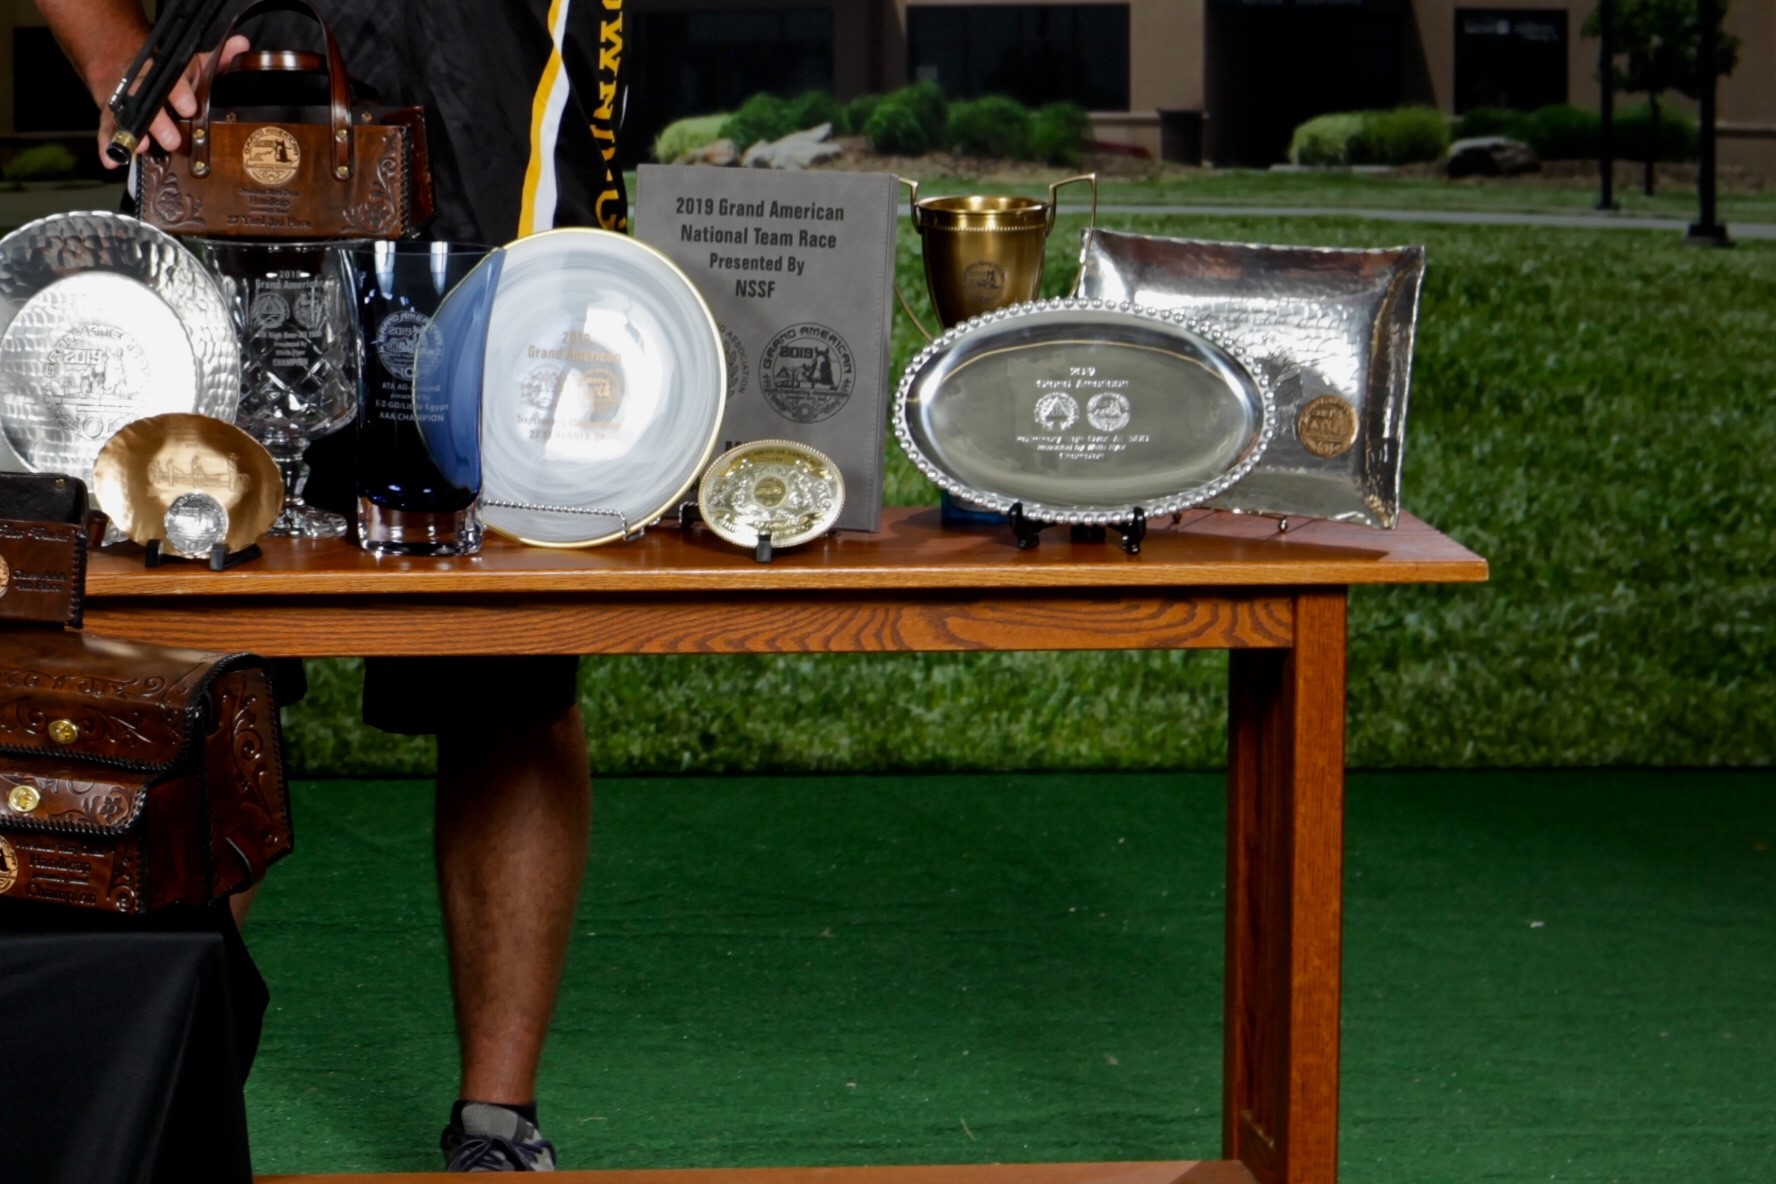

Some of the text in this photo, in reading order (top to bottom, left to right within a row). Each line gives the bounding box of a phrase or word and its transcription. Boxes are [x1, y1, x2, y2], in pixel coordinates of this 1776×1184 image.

[675, 197, 845, 221] 2019 Grand American
[241, 215, 266, 226] Yard
[680, 224, 837, 249] National Team Race
[709, 252, 805, 276] Presented By
[255, 278, 325, 290] Grand American
[735, 279, 776, 298] NSSF
[63, 348, 103, 365] 2019
[527, 344, 621, 363] Grand American
[763, 326, 852, 374] GRAND AMERICAN
[779, 346, 814, 359] 2019
[272, 358, 309, 367] CHAMPION
[726, 331, 750, 394] ASSOCIATION
[381, 382, 396, 390] ATA
[1036, 379, 1129, 389] Grand American
[375, 399, 449, 412] E-Z-GO/Litle Egypt
[378, 412, 444, 422] AAA CHAMPION
